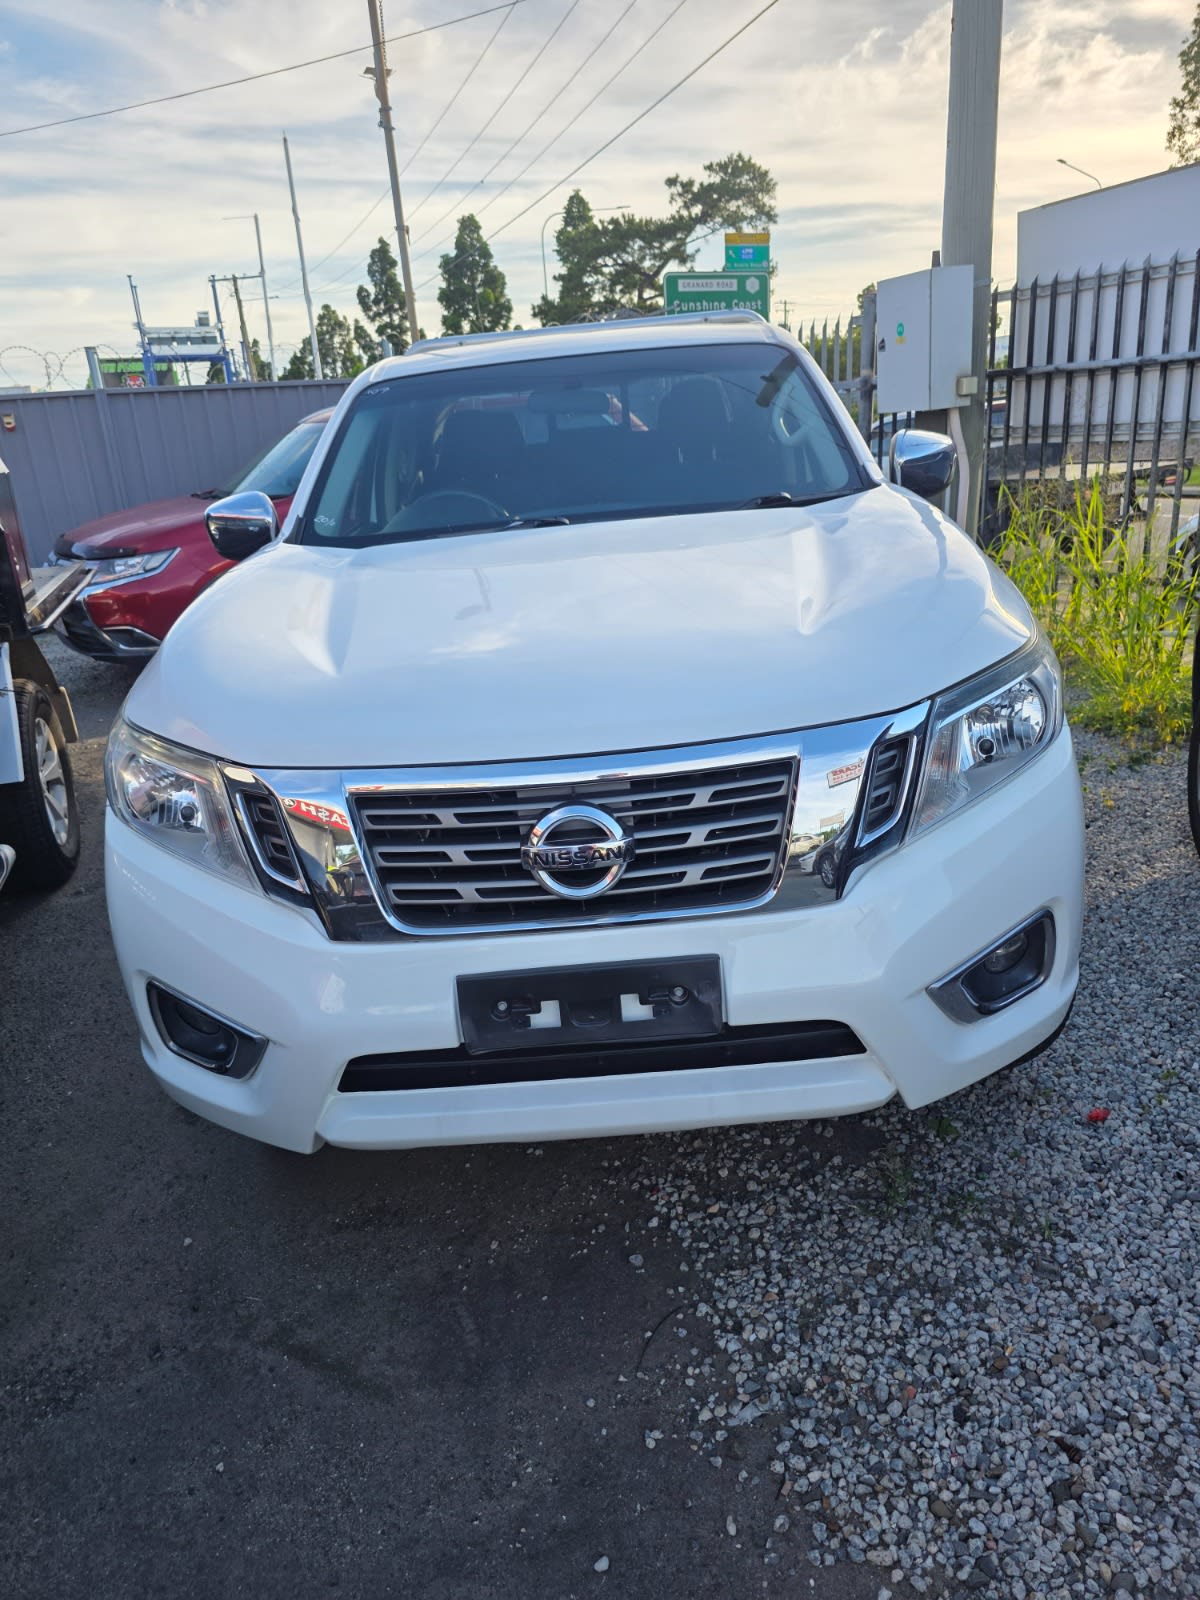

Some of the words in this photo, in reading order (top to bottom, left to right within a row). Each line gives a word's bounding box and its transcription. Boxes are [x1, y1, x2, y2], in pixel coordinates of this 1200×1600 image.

[682, 281, 714, 289] GRANARD
[673, 299, 726, 312] Sunshine
[732, 299, 762, 310] Coast
[532, 845, 623, 866] NISSAN
